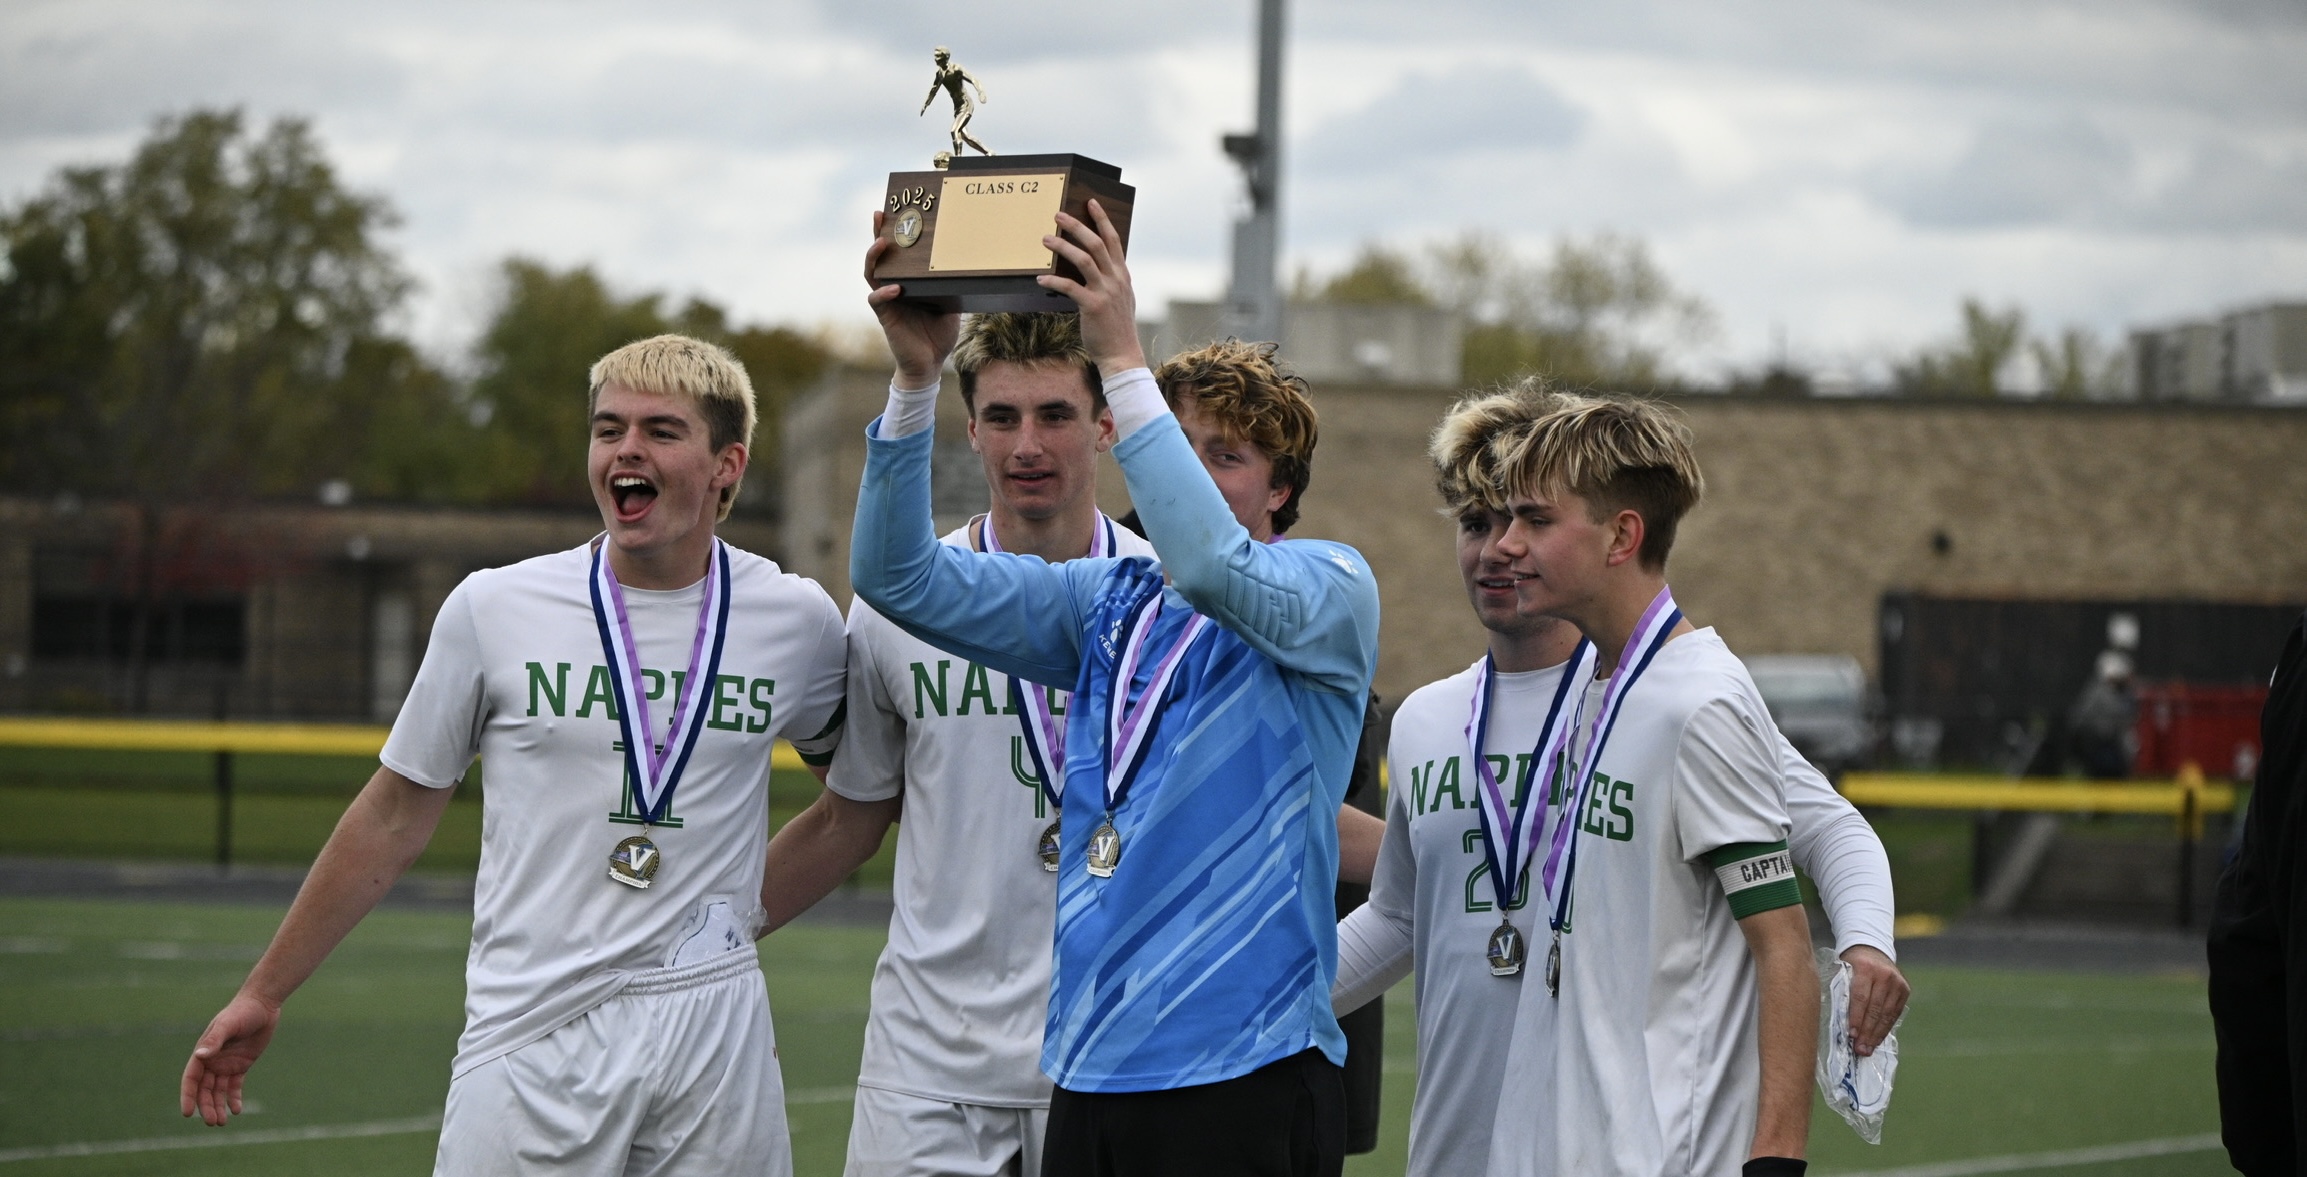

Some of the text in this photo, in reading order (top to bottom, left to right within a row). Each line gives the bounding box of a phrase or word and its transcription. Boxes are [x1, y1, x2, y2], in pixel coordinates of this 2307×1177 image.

[889, 186, 936, 212] 2025
[965, 181, 1039, 195] CLASS C2
[1740, 855, 1792, 883] CAPTAI
